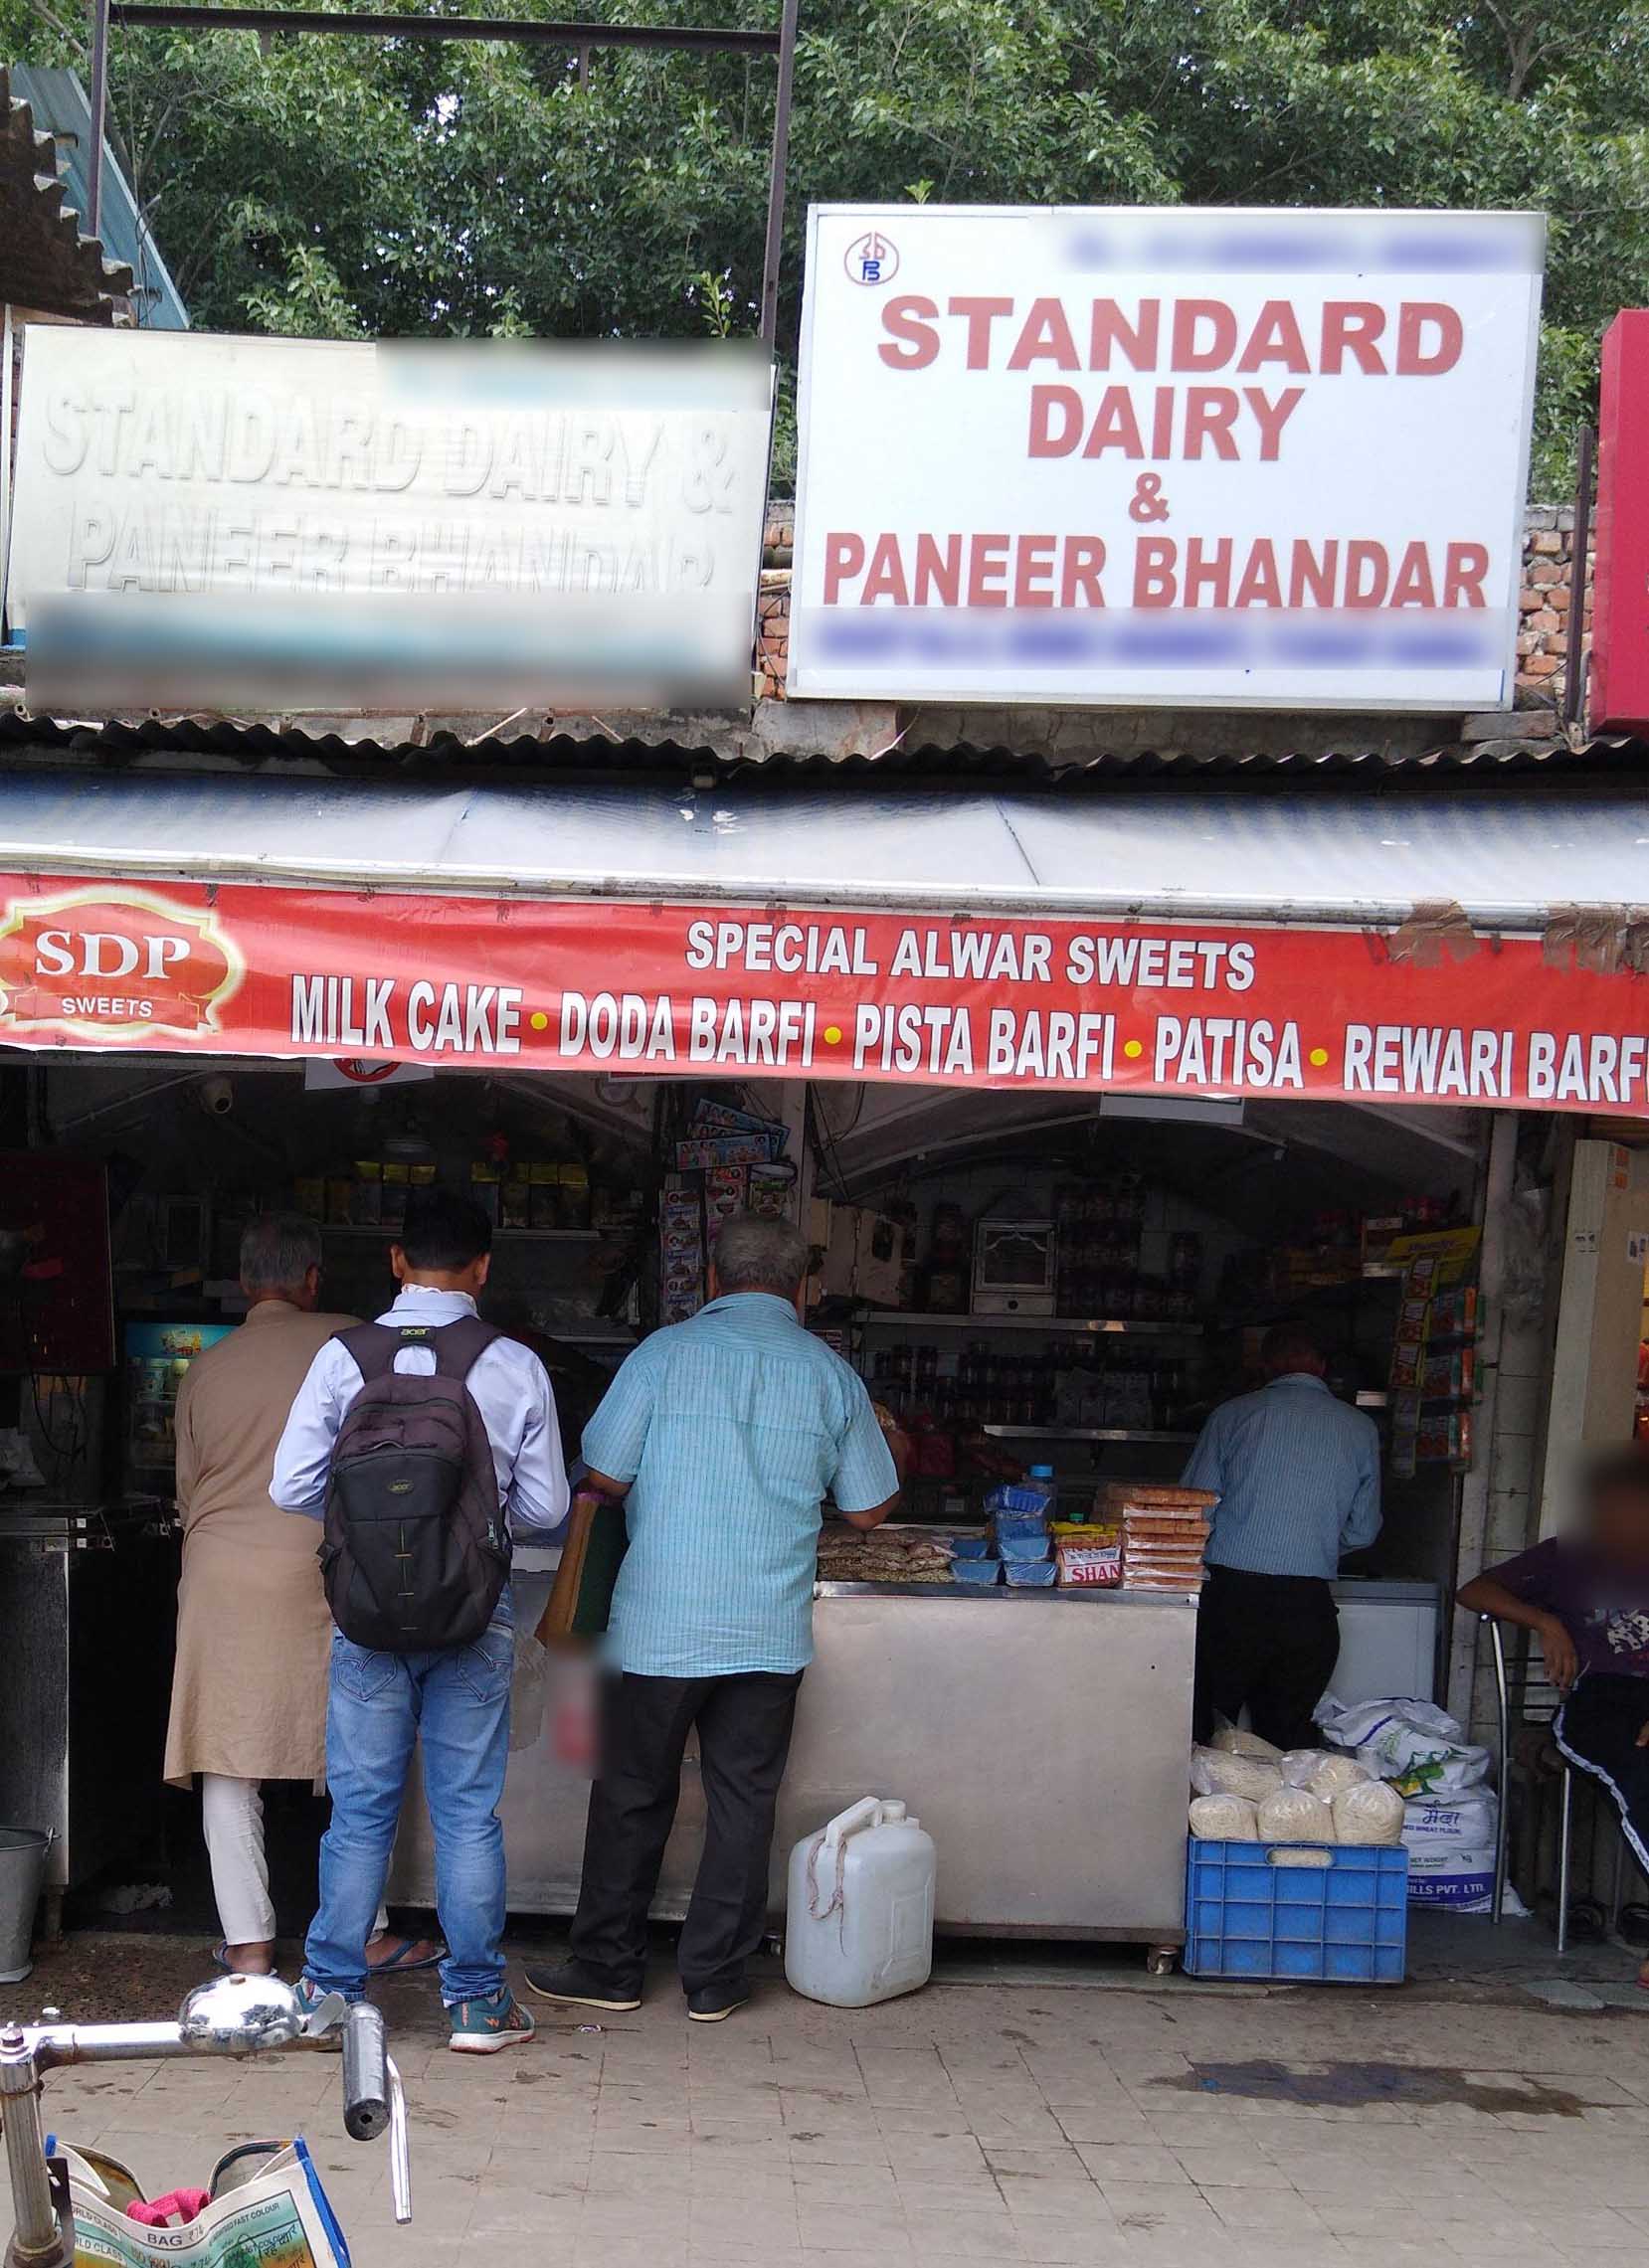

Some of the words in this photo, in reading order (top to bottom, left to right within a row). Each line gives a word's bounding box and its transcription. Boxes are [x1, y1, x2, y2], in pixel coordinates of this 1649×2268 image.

[878, 295, 1463, 376] STANDARD
[43, 390, 423, 493] STANDARD
[443, 406, 664, 508] DAIRY
[680, 422, 735, 514] &
[1027, 386, 1304, 461] DAIRY
[1129, 473, 1170, 522] &
[66, 499, 350, 595] PANEER
[370, 517, 718, 597] BHANDAR
[824, 532, 1106, 608] PANEER
[1132, 536, 1489, 609] BHANDAR
[35, 930, 192, 981] SDP
[685, 920, 878, 976] SPECIAL
[891, 929, 1051, 982] ALWAR
[1065, 936, 1256, 992] SWEETS
[61, 996, 154, 1019] SWEETS
[290, 973, 397, 1049] MILK
[406, 980, 522, 1055] CAKE
[559, 991, 675, 1062] DODA
[689, 999, 816, 1068] BARFI
[853, 1002, 974, 1075] PISTA
[989, 1006, 1115, 1081] BARFI
[1155, 1016, 1305, 1090] PATISA
[1343, 1024, 1514, 1099] REWARI
[1527, 1031, 1649, 1104] BARF
[401, 1327, 430, 1336] acer
[147, 2232, 182, 2246] BAG
[250, 2201, 280, 2219] COLOUR
